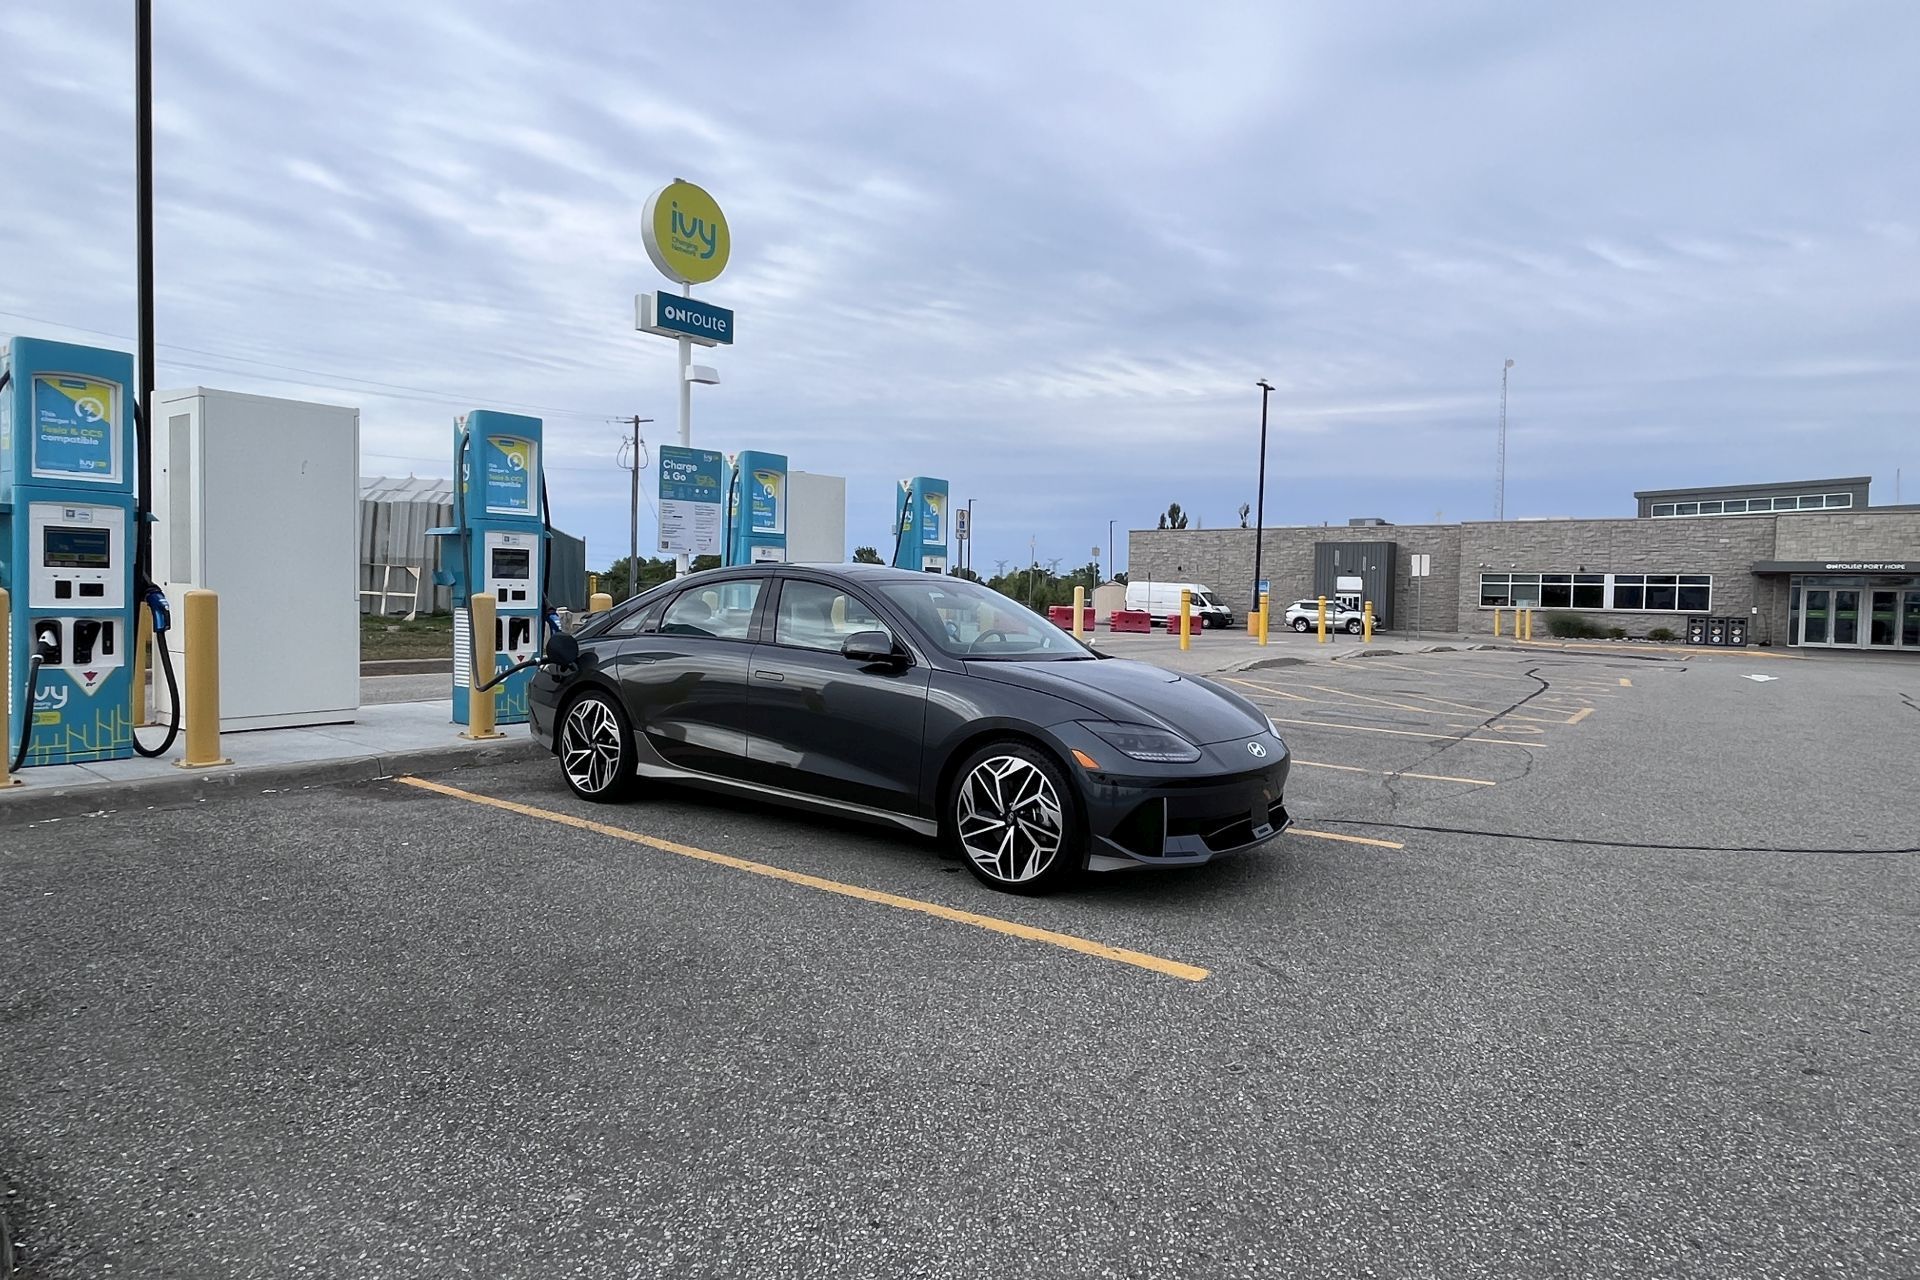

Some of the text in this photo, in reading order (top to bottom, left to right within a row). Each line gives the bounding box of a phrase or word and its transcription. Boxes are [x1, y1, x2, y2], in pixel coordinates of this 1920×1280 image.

[671, 200, 717, 260] ivy
[664, 305, 727, 332] ONroute
[40, 409, 57, 418] This
[41, 424, 67, 434] Tesla
[80, 429, 104, 439] CCS
[40, 434, 99, 445] compatible
[79, 458, 95, 469] ivy
[662, 459, 698, 473] Charge
[662, 470, 687, 481] & Go
